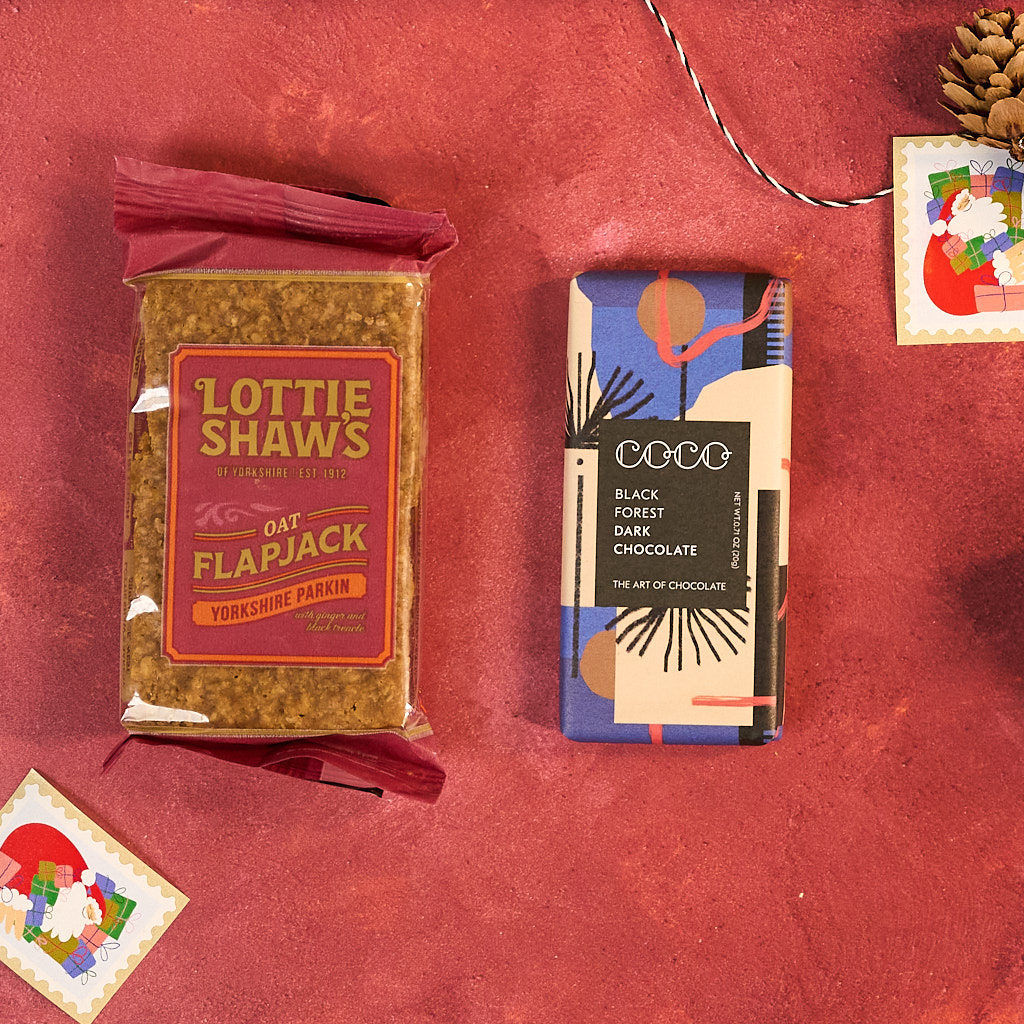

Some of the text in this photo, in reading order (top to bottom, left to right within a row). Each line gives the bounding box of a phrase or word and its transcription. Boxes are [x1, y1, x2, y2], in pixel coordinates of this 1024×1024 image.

[194, 377, 372, 418] LOTTIE
[200, 411, 370, 459] SHAW'S
[615, 439, 732, 470] COCO
[217, 466, 347, 480] OF YORKSHIRE EST 1912
[615, 488, 659, 501] BLACK
[614, 507, 665, 519] FOREST
[263, 512, 301, 538] OAT
[614, 525, 651, 537] DARK
[193, 523, 368, 580] FLAPJACK
[613, 543, 698, 557] CHOCOLATE
[732, 537, 740, 549] OZ
[731, 549, 740, 570] (20g)
[613, 579, 727, 591] THE ART OF CHOCOLATE
[210, 578, 350, 622] YORKSHIRE PARKIN
